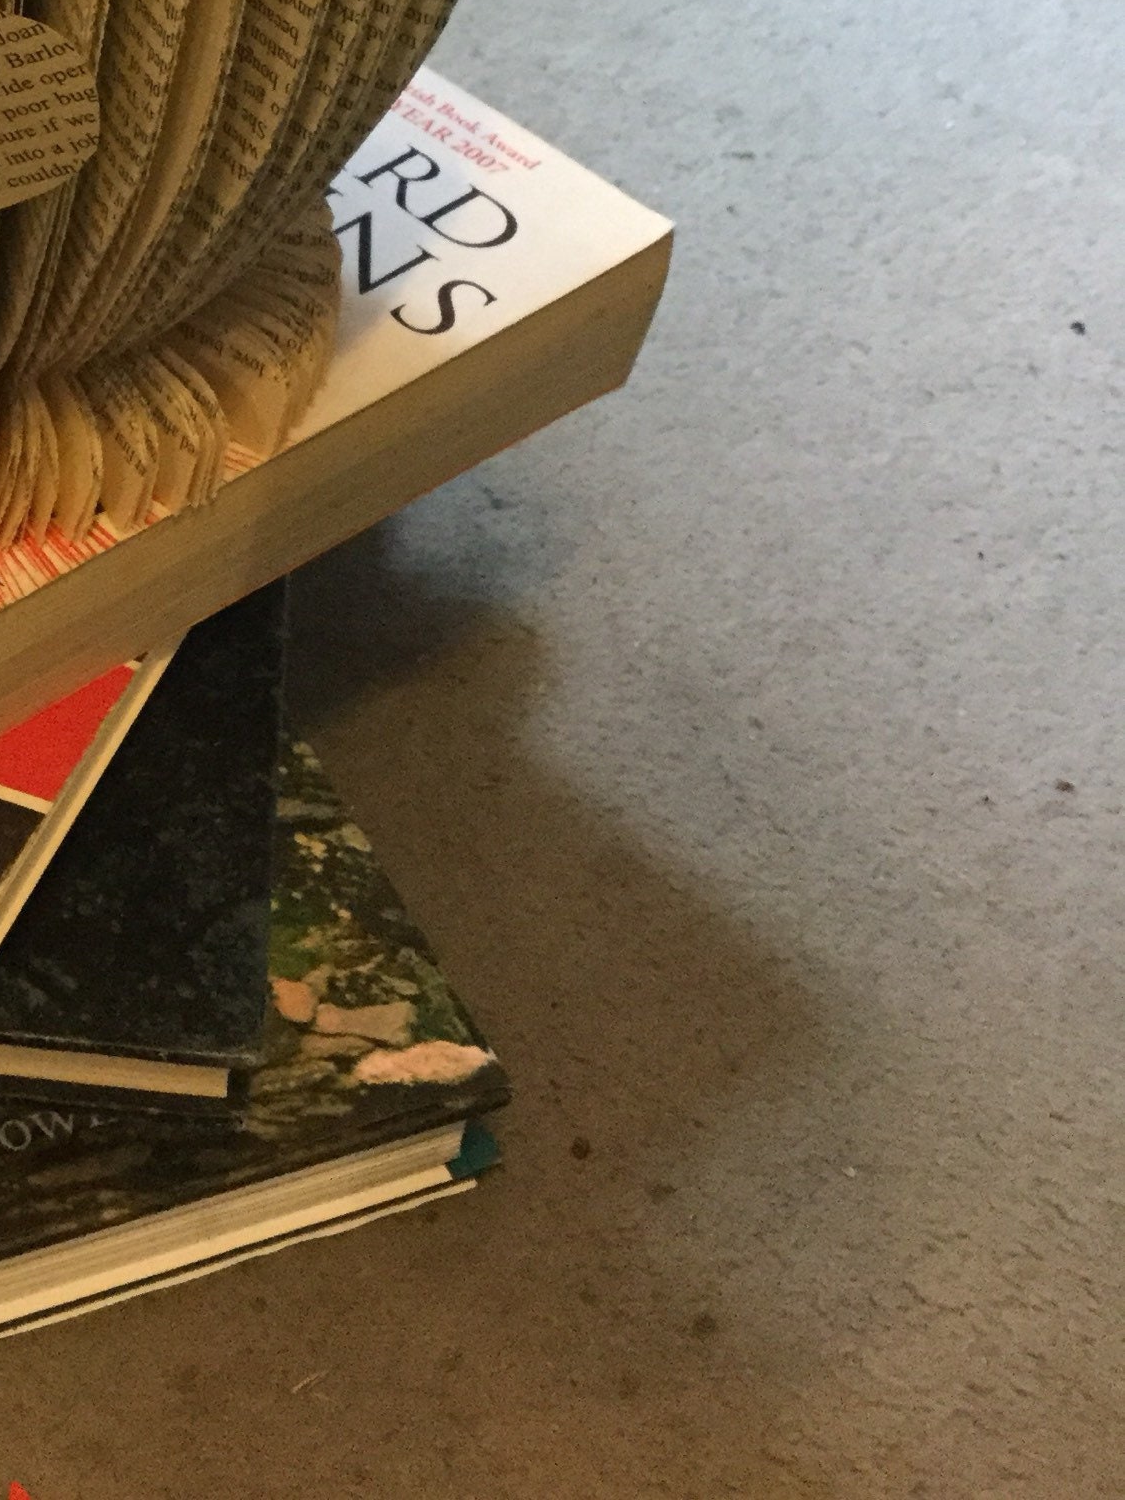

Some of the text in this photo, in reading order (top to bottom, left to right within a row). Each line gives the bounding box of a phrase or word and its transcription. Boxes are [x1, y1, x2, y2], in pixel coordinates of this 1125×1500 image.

[0, 99, 51, 122] poor
[435, 97, 543, 174] Book Award
[448, 133, 510, 181] 2007
